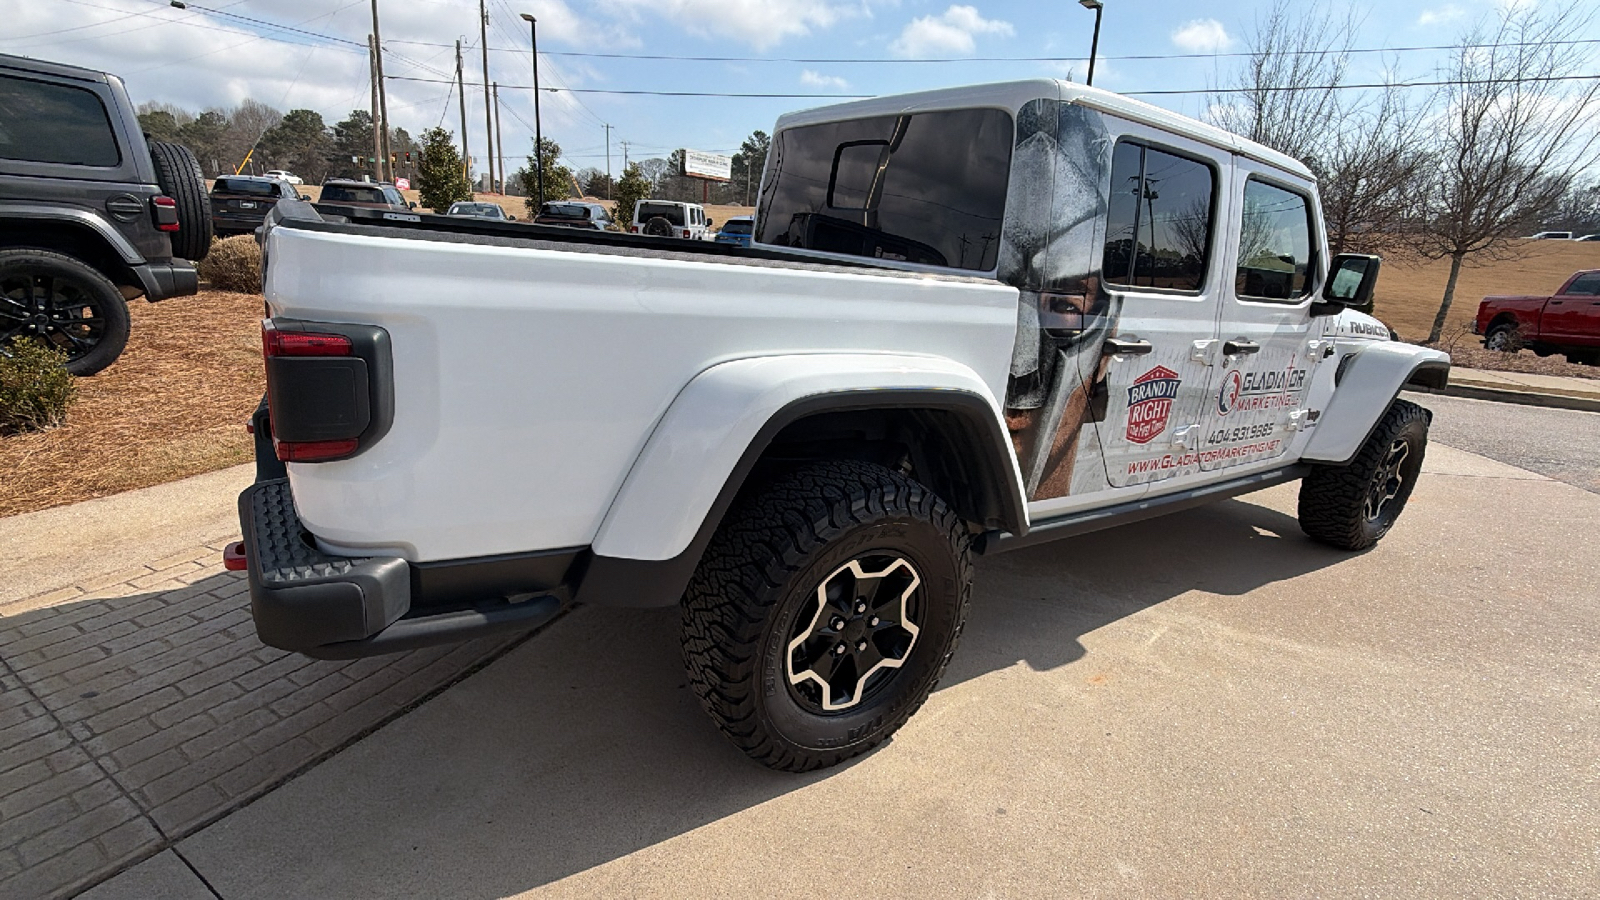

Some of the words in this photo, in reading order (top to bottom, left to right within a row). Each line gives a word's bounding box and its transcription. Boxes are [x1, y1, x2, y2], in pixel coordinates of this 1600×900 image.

[1242, 369, 1306, 391] GLADIATOR
[1131, 381, 1166, 404] BRAND
[1167, 381, 1179, 396] IT
[1236, 394, 1291, 411] MARKETING
[1131, 400, 1170, 423] RIGHT
